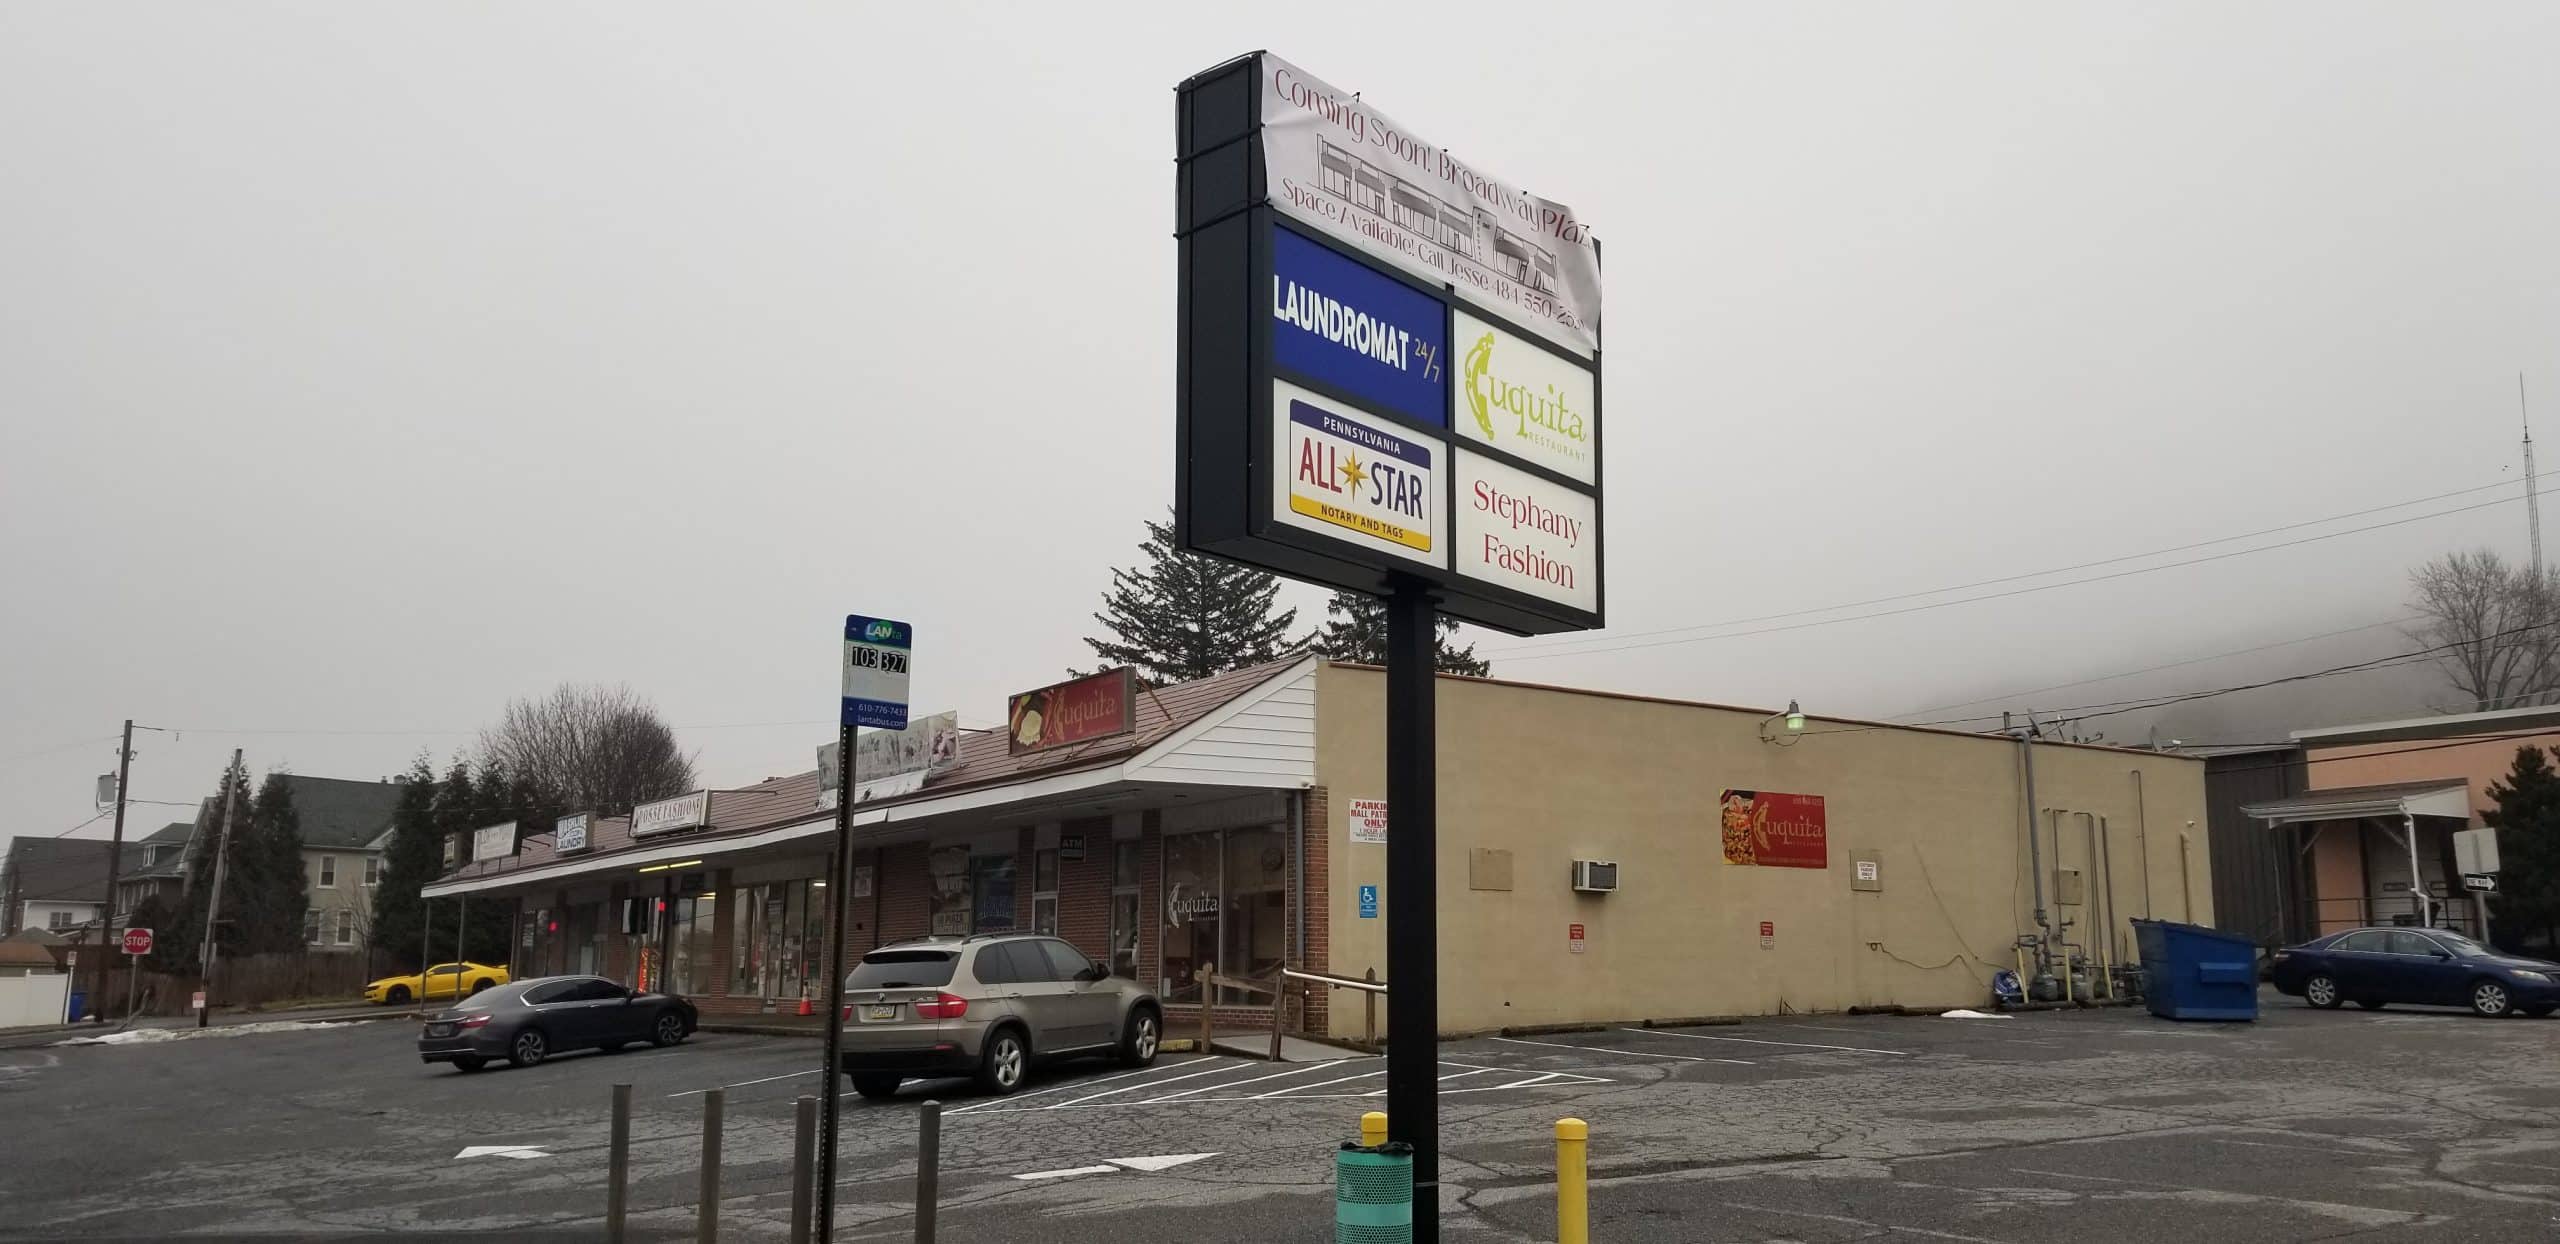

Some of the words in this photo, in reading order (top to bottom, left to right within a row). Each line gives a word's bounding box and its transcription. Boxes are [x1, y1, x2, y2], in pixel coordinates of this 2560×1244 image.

[1275, 69, 1364, 143] Coming
[1370, 118, 1431, 173] Soon!
[1438, 152, 1540, 232] Broadway
[1282, 177, 1336, 220] Space
[1340, 207, 1415, 257] Available!
[1418, 243, 1444, 270] Call
[1447, 257, 1489, 291] Jesse
[1273, 275, 1409, 371] LAUNDROMAT
[1414, 337, 1440, 383] 24/7
[1323, 416, 1401, 454] PENNSYLVANIA
[1528, 434, 1586, 462] RESTAURANT
[1299, 437, 1342, 494] ALL
[1370, 461, 1423, 520] STAR
[1321, 503, 1357, 525] NOTARY
[1360, 515, 1379, 530] AND
[1382, 521, 1404, 539] TAGS
[1473, 479, 1582, 548] Stephany
[1484, 533, 1575, 590] Fashion
[853, 647, 878, 668] 103
[882, 653, 906, 673] 327
[1351, 810, 1368, 818] MALL
[1364, 818, 1387, 828] ONLY
[1062, 839, 1082, 849] ATM
[125, 935, 151, 947] STOP
